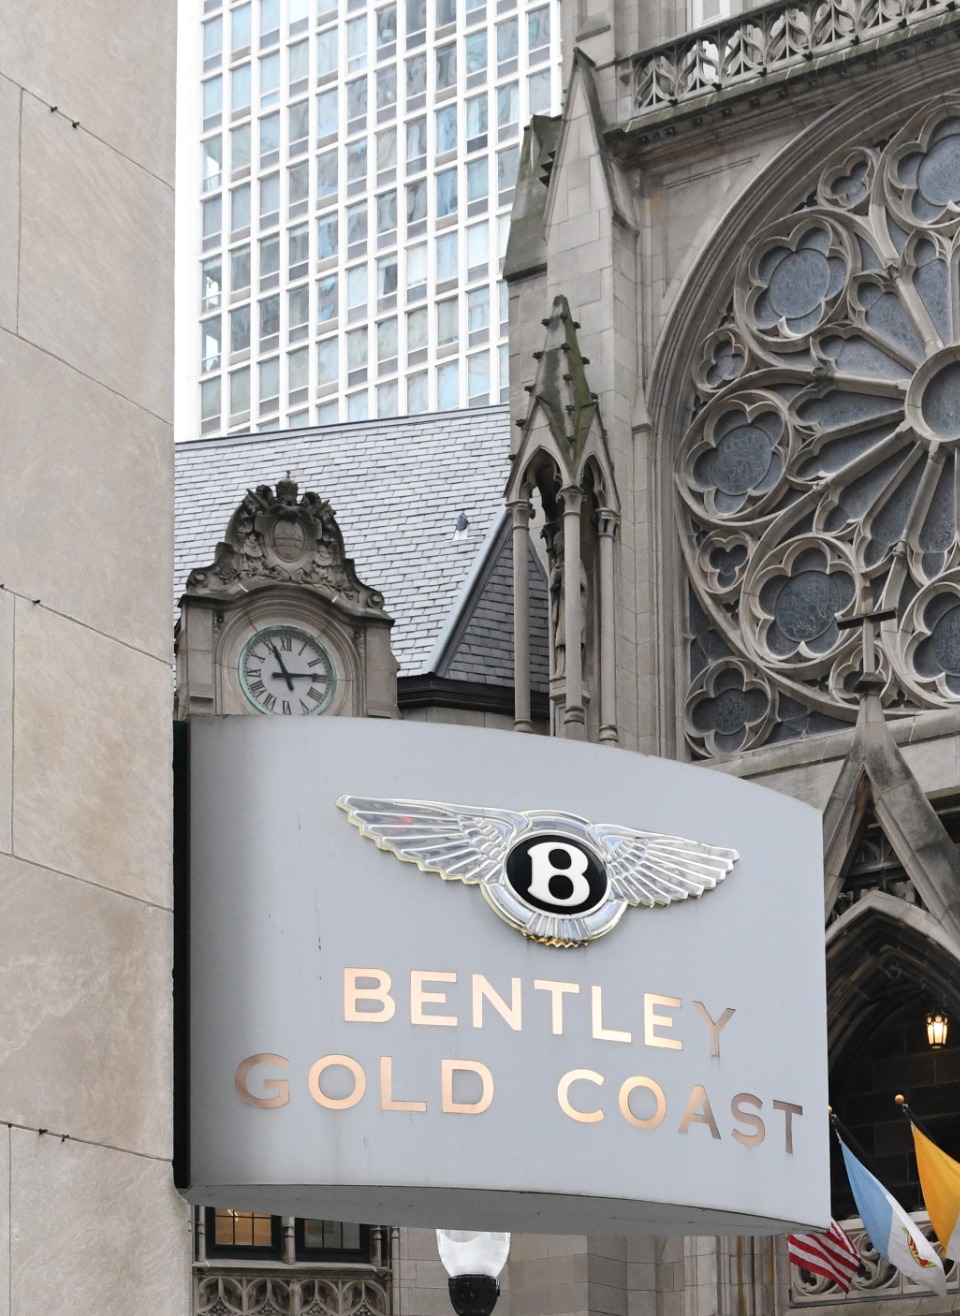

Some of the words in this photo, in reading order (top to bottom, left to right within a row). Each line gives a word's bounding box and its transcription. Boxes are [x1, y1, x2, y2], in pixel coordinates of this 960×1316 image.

[528, 841, 591, 907] B
[343, 966, 737, 1058] BENTLEY
[234, 1053, 494, 1115] GOLD
[556, 1068, 804, 1154] COAST
